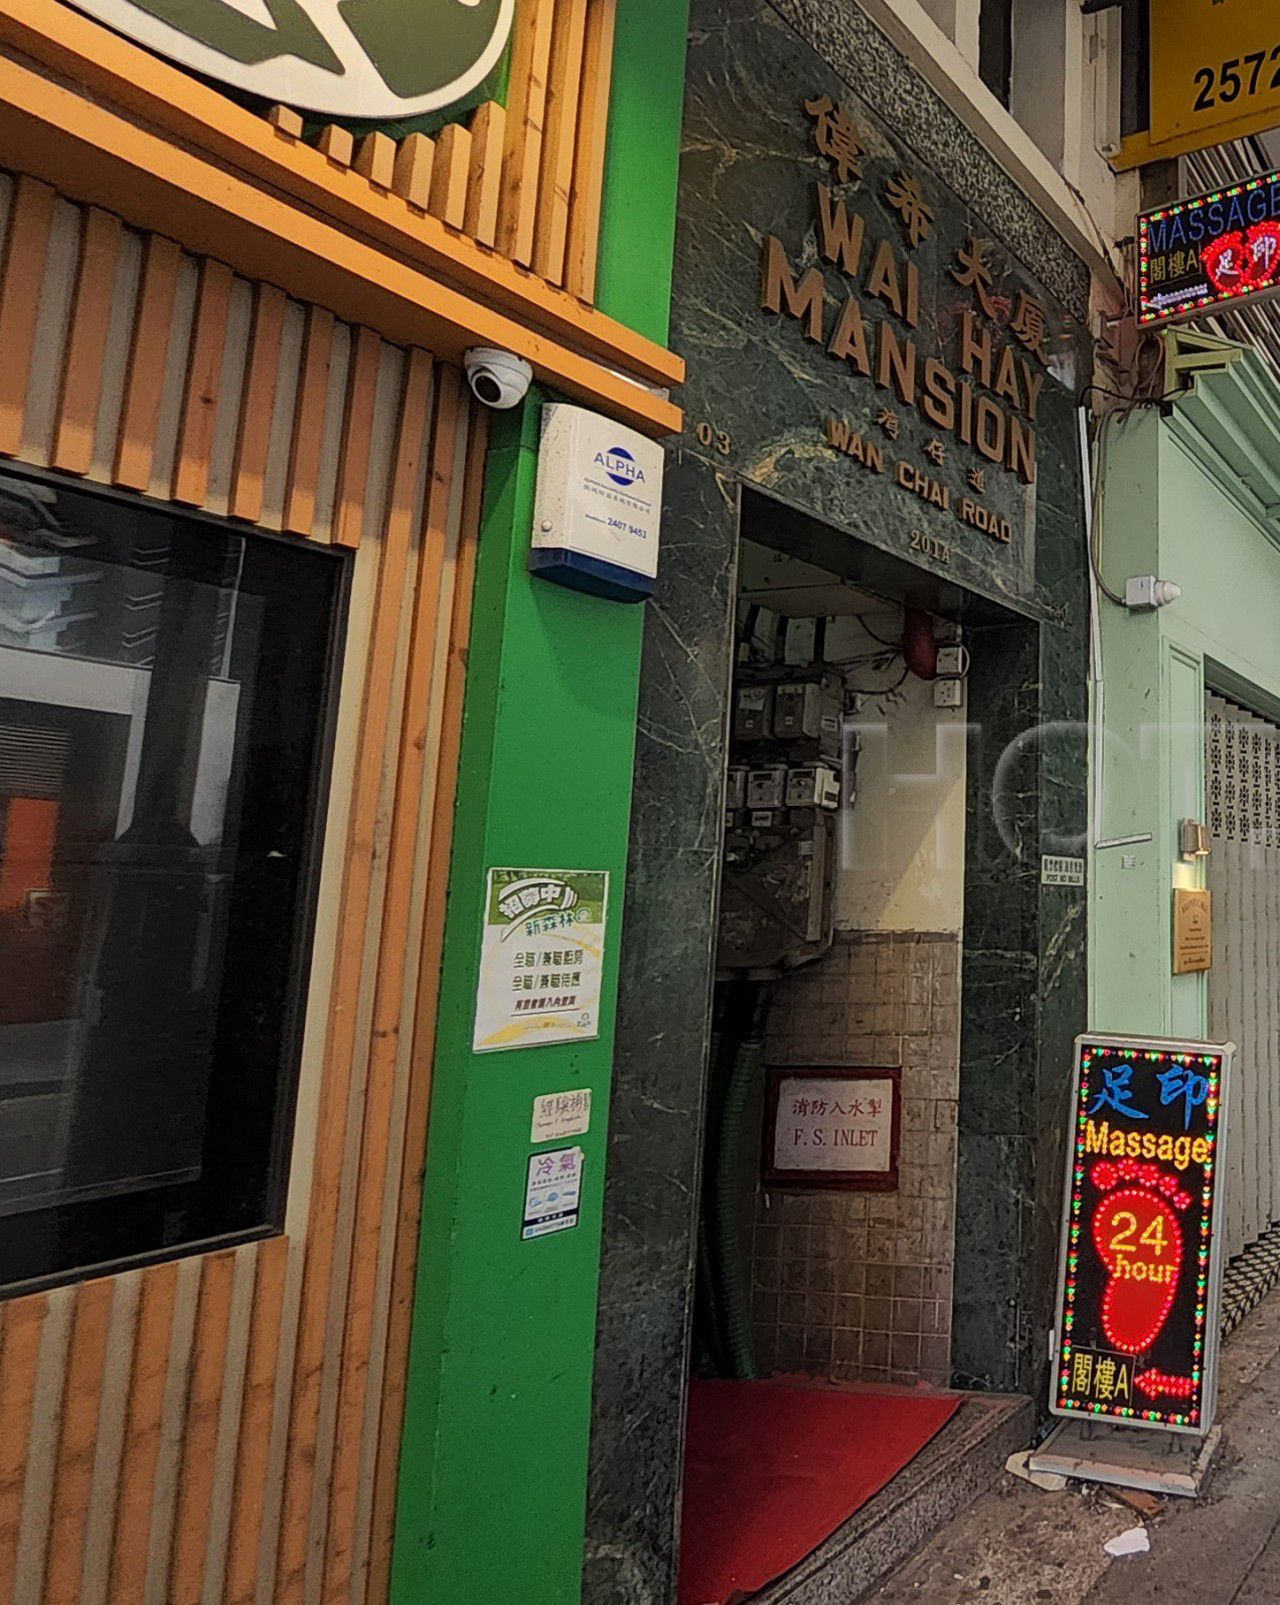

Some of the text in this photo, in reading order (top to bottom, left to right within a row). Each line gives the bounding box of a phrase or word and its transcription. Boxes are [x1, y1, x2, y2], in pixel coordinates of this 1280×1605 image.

[1150, 249, 1199, 283] 閣樓A
[816, 180, 1045, 421] WAI HAY
[761, 235, 1036, 484] MANSION
[593, 452, 646, 484] ALPHA
[877, 408, 987, 493] 灣仔道
[827, 418, 1013, 544] WAN CHAI ROAD
[910, 530, 953, 564] 201A
[526, 911, 575, 936] 新森林
[792, 1097, 882, 1118] 消防入水掣
[1088, 1062, 1209, 1131] 足印
[793, 1128, 878, 1147] F. S. INLET
[1085, 1119, 1212, 1170] Massage
[536, 1153, 577, 1176] 冷氣
[1109, 1210, 1169, 1257] 24
[1112, 1253, 1177, 1283] hour
[1072, 1351, 1130, 1401] 閣樓A
